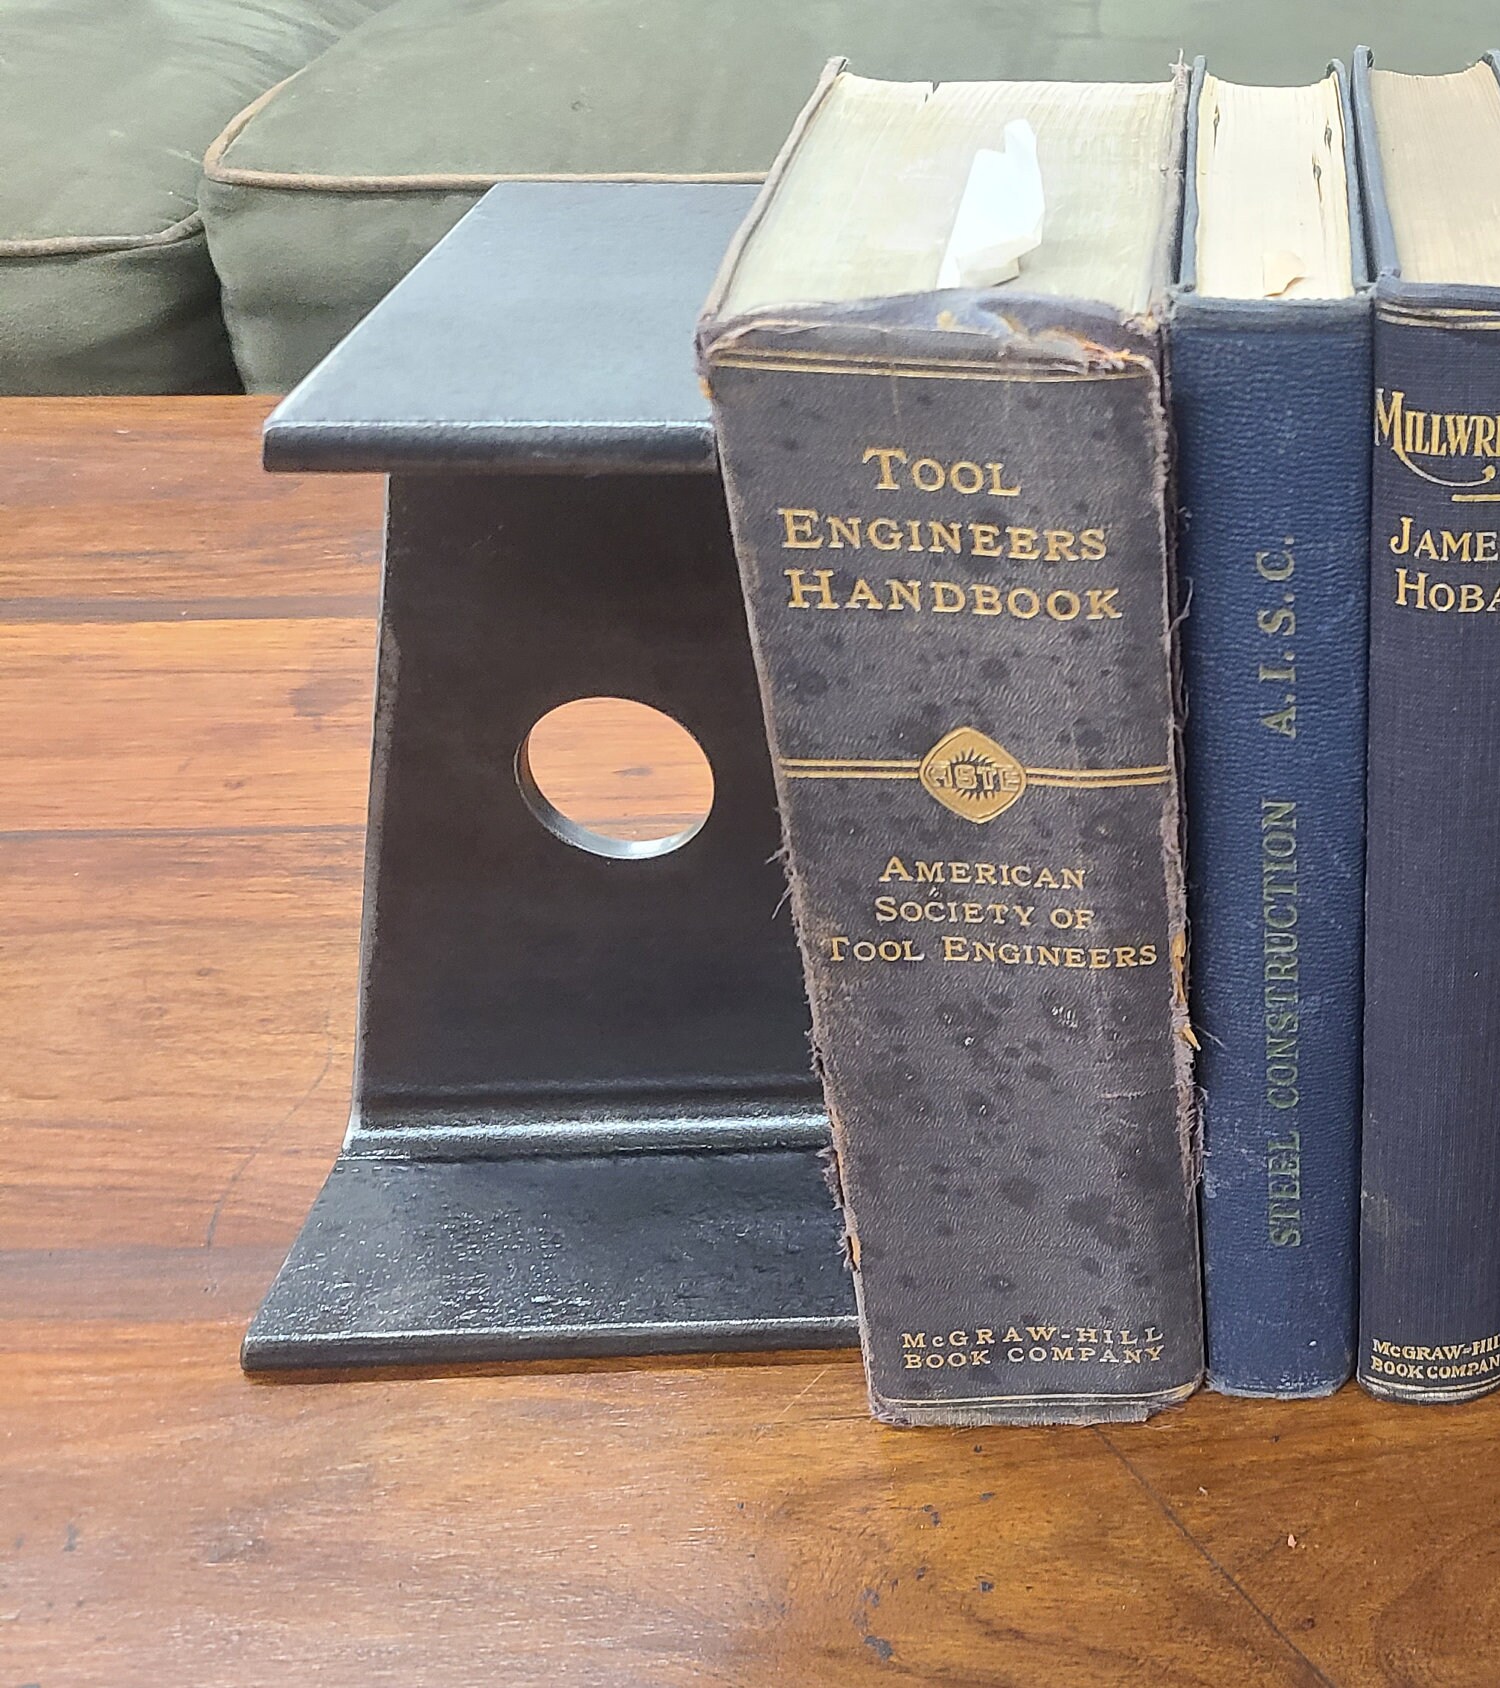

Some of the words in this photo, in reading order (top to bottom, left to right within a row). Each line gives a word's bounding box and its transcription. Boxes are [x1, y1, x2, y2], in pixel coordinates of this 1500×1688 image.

[862, 447, 1022, 498] TOOL
[778, 508, 1108, 562] ENGINEERS
[784, 567, 1124, 621] HANDBOOK
[878, 855, 1086, 890] AMERICAN
[874, 896, 1036, 928] SOCIETY
[1050, 906, 1096, 931] OF
[830, 936, 925, 963] TOOL
[941, 935, 1158, 970] ENGINEERS
[1260, 798, 1300, 1110] CONSTRUCTION
[1265, 1130, 1302, 1248] STEEL
[901, 1325, 1164, 1350] McGRAW-HILL
[903, 1350, 991, 1370] BOOK
[1006, 1344, 1166, 1365] COMPANY
[1371, 1355, 1425, 1379] BOOK
